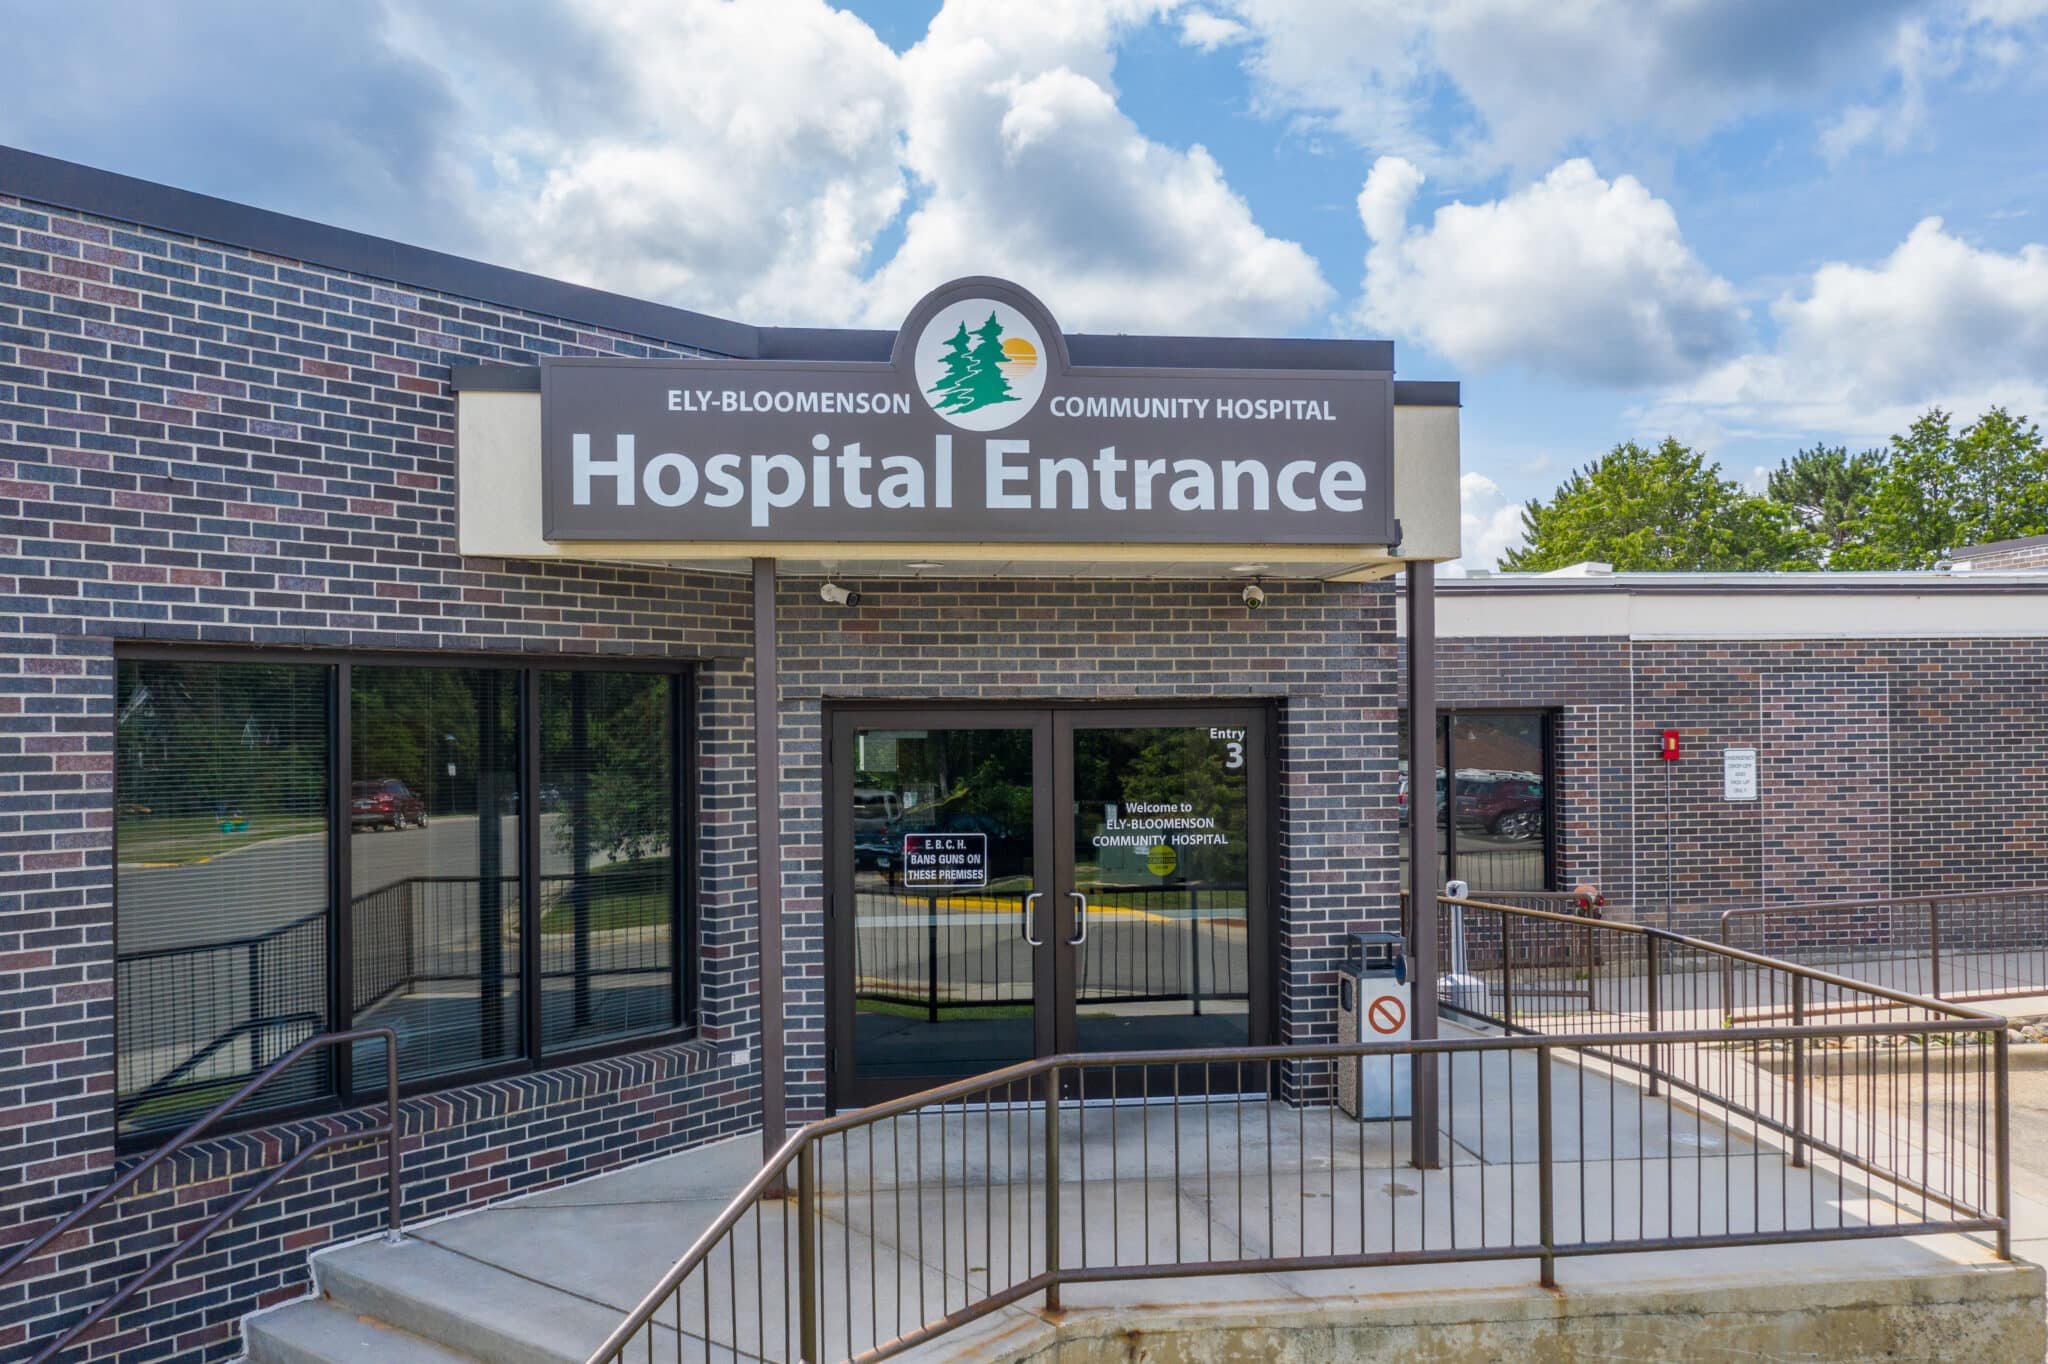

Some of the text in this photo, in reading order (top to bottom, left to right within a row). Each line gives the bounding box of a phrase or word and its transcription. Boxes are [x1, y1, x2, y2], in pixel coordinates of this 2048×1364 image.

[667, 389, 911, 415] ELY-BLOOMENSON
[1049, 396, 1336, 421] COMMUNITY HOSPITAL
[572, 433, 1367, 528] Hospital Entrance
[1209, 727, 1245, 741] Entry
[1225, 742, 1244, 769] 3
[1126, 802, 1193, 813] Welcome to
[1106, 818, 1214, 830] ELY-BLOOMENSON
[1092, 834, 1229, 847] COMMUNITY HOSPITAL
[911, 854, 981, 865] BANS GUNS ON
[908, 869, 984, 880] THESE PREMISES
